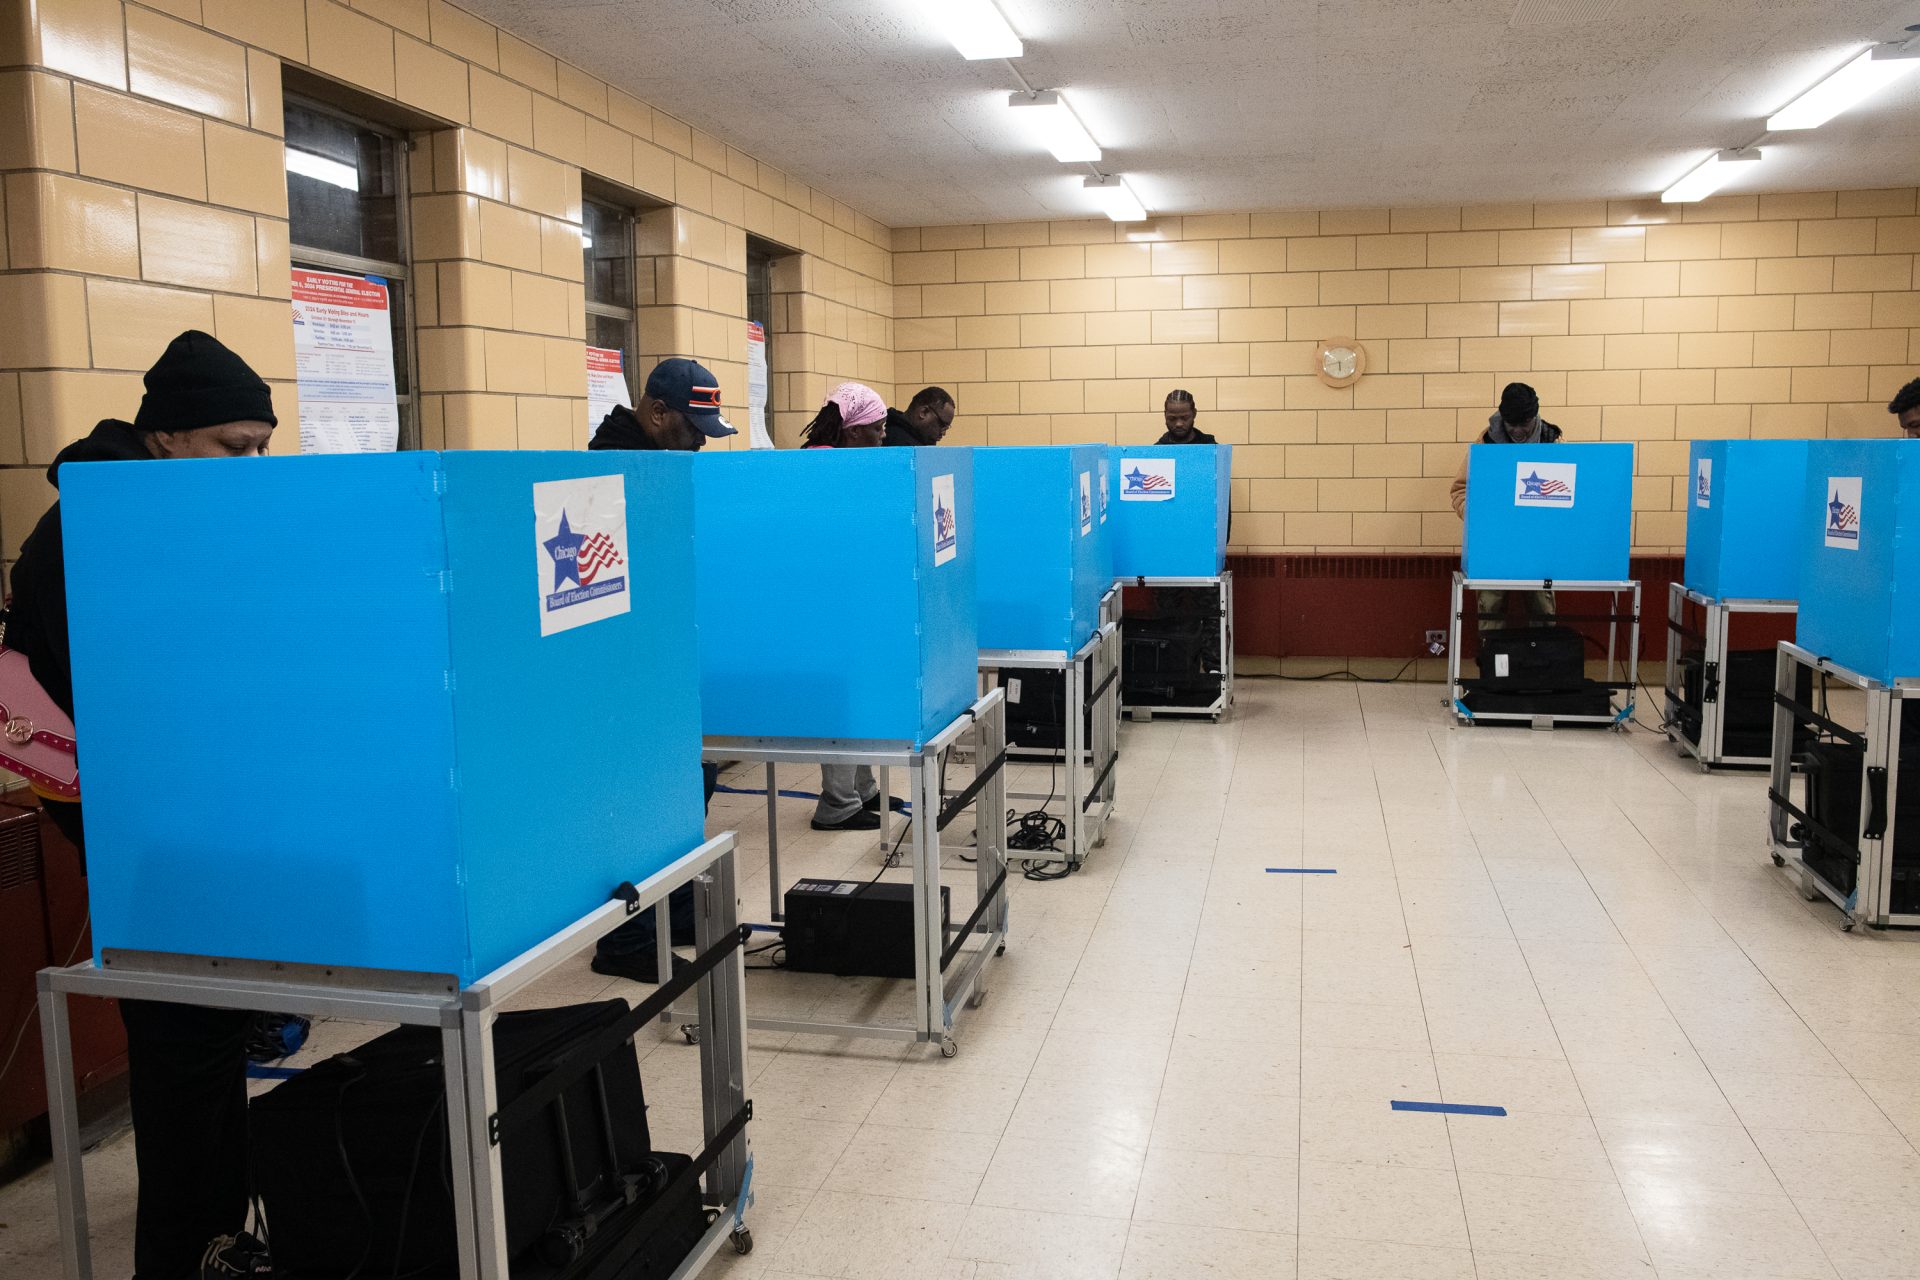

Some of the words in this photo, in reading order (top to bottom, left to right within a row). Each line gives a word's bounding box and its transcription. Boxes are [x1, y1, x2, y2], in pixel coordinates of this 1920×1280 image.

[555, 546, 577, 561] Chicago
[549, 592, 565, 608] Board
[565, 591, 571, 603] of
[571, 588, 590, 602] Election
[590, 582, 622, 598] Commissioners
